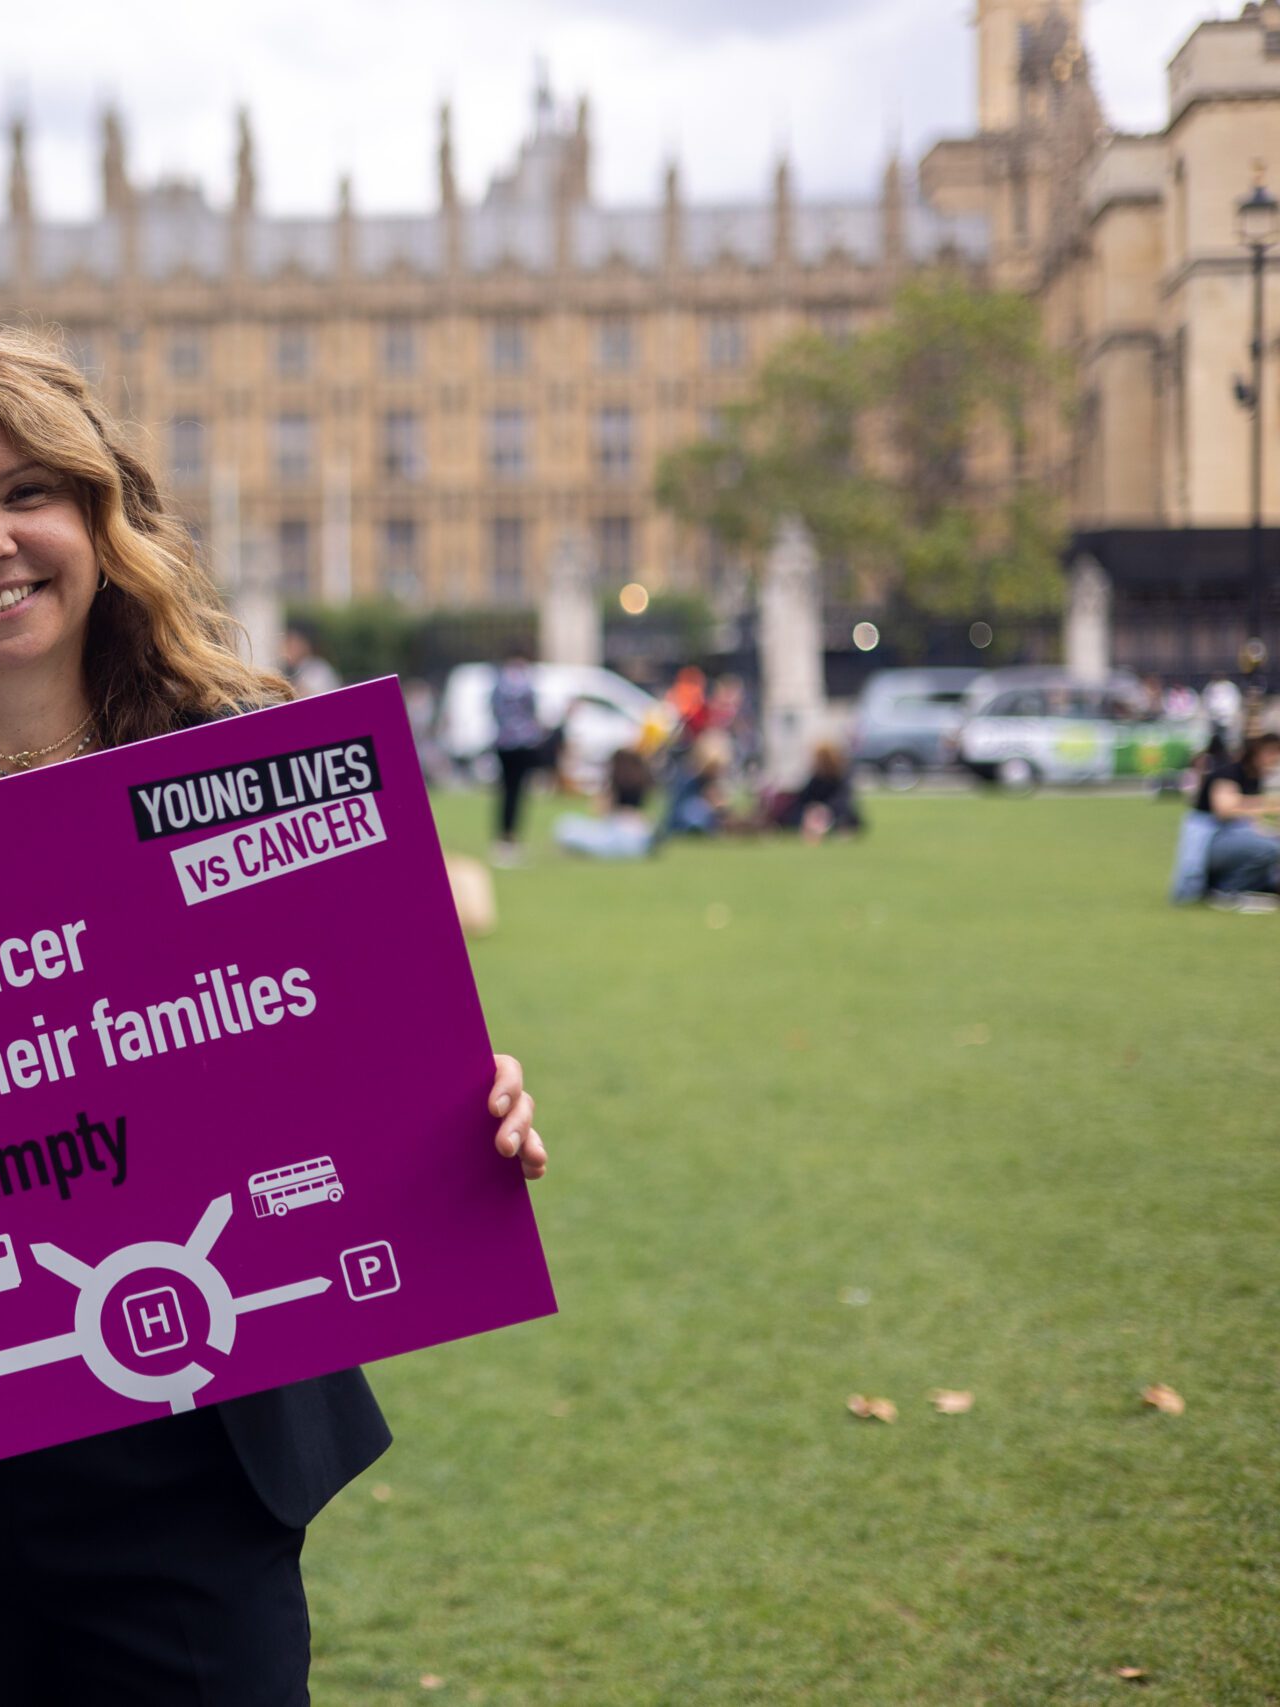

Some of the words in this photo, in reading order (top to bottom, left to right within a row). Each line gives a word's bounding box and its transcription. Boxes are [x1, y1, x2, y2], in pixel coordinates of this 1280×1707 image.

[137, 767, 264, 834] YOUNG
[268, 744, 372, 808] LIVES
[185, 855, 231, 893] vs
[232, 797, 376, 877] CANCER
[90, 963, 317, 1068] families
[358, 1255, 381, 1287] P
[139, 1302, 171, 1338] H
